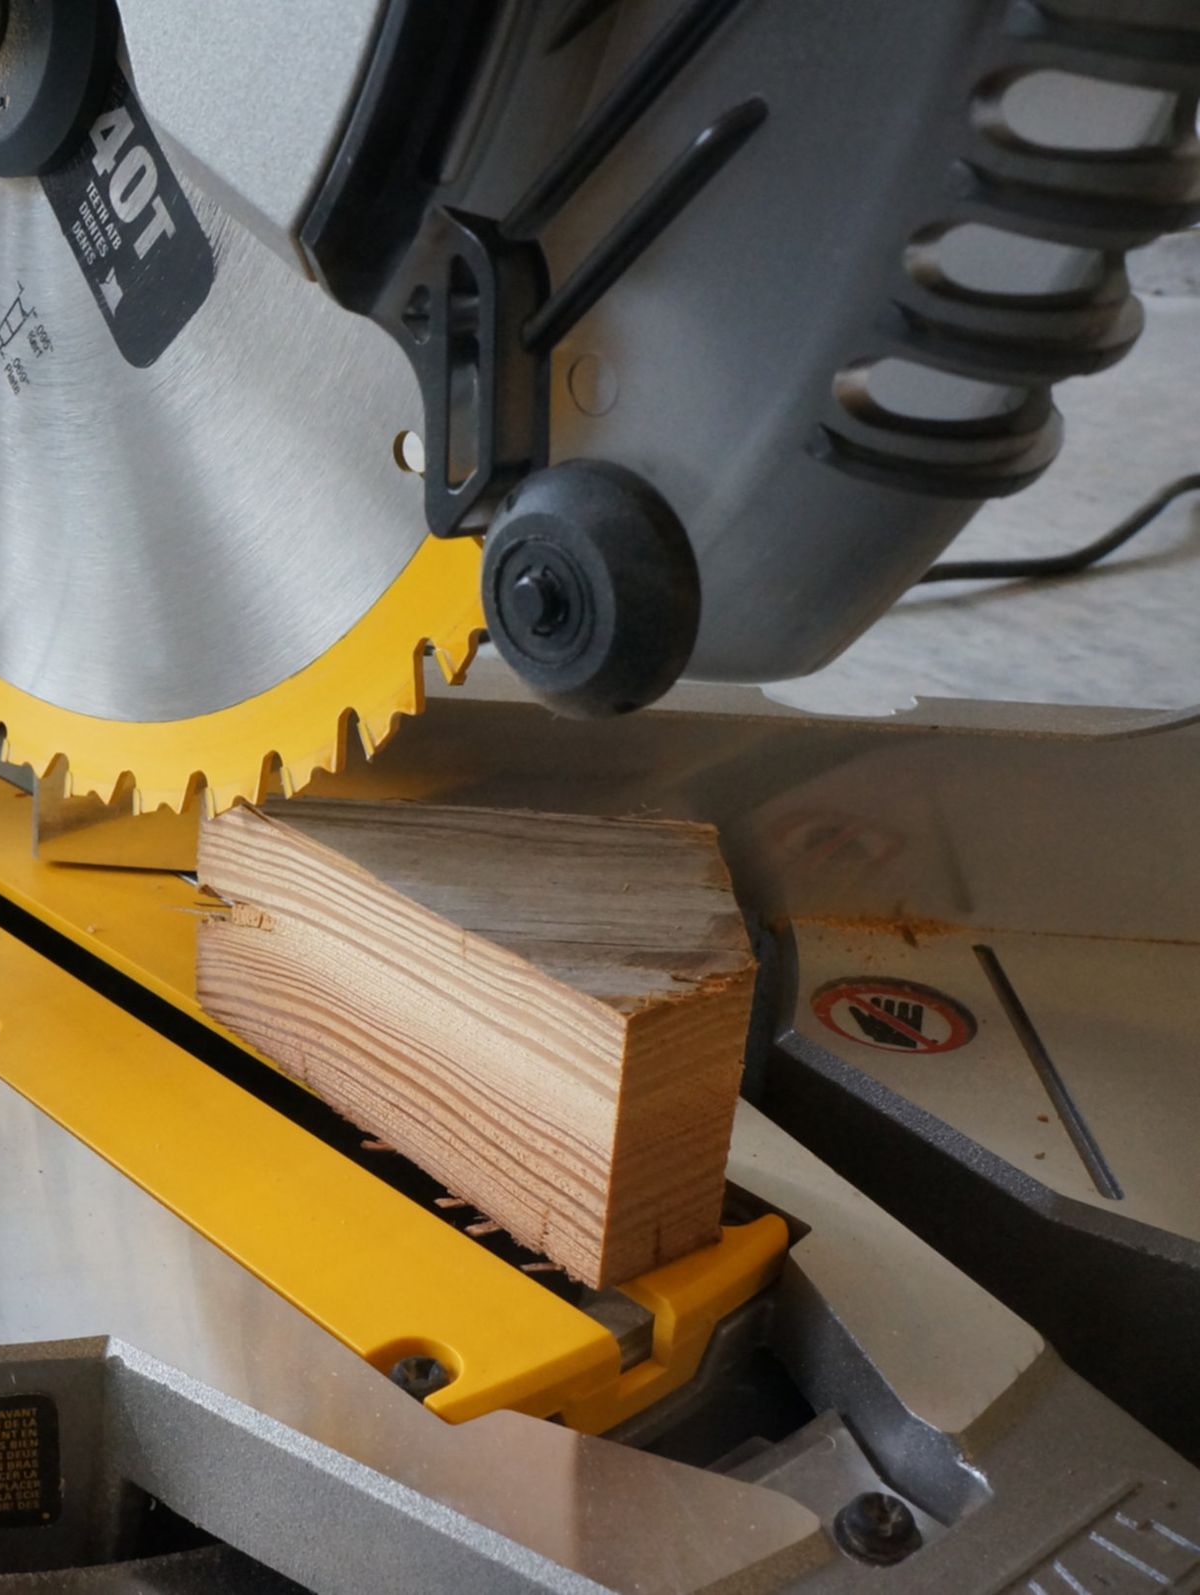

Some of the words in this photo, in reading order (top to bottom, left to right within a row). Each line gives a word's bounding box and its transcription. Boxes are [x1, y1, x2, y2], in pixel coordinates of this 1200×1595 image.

[89, 107, 176, 260] 40T
[71, 220, 97, 266] DENTS
[78, 201, 110, 258] DIENTES
[85, 181, 112, 226] TEETH
[104, 221, 122, 251] ATB
